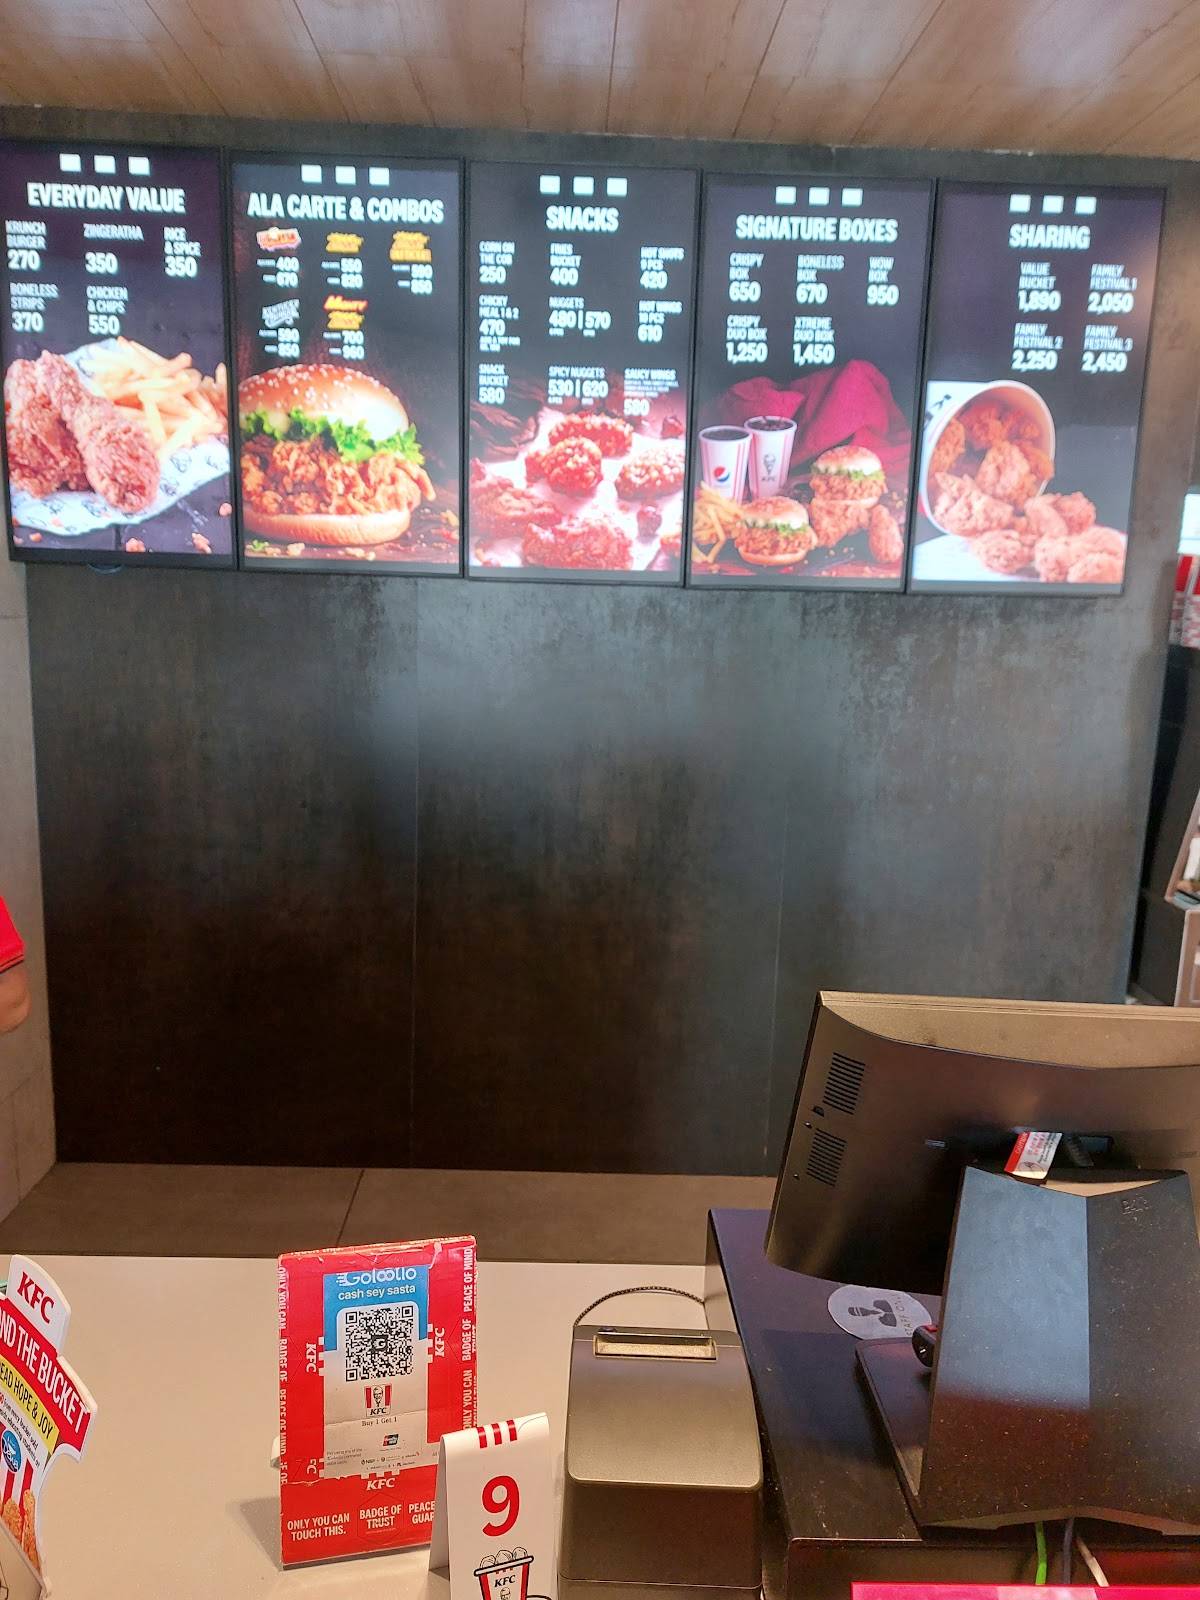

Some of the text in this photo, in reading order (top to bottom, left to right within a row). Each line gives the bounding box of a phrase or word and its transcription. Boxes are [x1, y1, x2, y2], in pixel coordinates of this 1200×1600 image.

[27, 182, 186, 214] EVERYDAY VALUE
[248, 192, 444, 224] ALA CARTE & COMBOS
[546, 206, 618, 232] SNACKS
[164, 226, 186, 241] RICE
[735, 214, 898, 243] SIGNATURE BOXES
[6, 235, 46, 249] BURGER
[1008, 224, 1091, 250] SHARING
[164, 242, 200, 256] & SPICE
[479, 241, 502, 254] CORN
[640, 246, 657, 260] HOT
[8, 250, 40, 270] 270
[84, 252, 118, 274] 350
[164, 256, 198, 278] 350
[480, 253, 513, 266] THE COB
[550, 255, 582, 268] BUCKET
[648, 259, 664, 272] PCS
[730, 252, 764, 268] CRISPY
[797, 254, 845, 270] BONELESS
[868, 256, 894, 270] WOW
[479, 266, 506, 284] 250
[550, 267, 579, 286] 400
[730, 267, 750, 280] BOX
[796, 269, 818, 282] BOX
[868, 270, 888, 283] BOX
[1020, 262, 1050, 276] VALUE
[1091, 264, 1124, 278] FAMILY
[640, 270, 668, 290] 420
[1018, 276, 1056, 290] BUCKET
[1089, 277, 1131, 291] FESTIVAL
[10, 282, 58, 298] BONELESS
[86, 286, 128, 301] CHICKEN
[728, 280, 762, 302] 650
[796, 282, 828, 304] 670
[866, 284, 900, 306] 950
[11, 297, 46, 311] STRIPS
[88, 300, 126, 314] & CHIPS
[549, 296, 584, 309] NUGGETS
[638, 300, 656, 312] HOT
[1087, 292, 1134, 315] 2,050
[479, 306, 500, 319] MEAL
[548, 310, 611, 330] 480 570
[648, 312, 664, 325] PCS
[12, 312, 44, 332] 370
[88, 314, 120, 336] 550
[480, 319, 506, 336] 470
[727, 314, 761, 328] CRISPY
[638, 324, 663, 342] 610
[726, 328, 768, 342] DUO BOX
[794, 328, 834, 342] DUO BOX
[1014, 322, 1048, 337] FAMILY
[1084, 324, 1118, 338] FAMILY
[1013, 336, 1064, 350] FESTIVAL 2
[1084, 337, 1134, 352] FESTIVAL 3
[726, 342, 768, 365] 1,250
[793, 344, 836, 366] 1,450
[1011, 350, 1058, 372] 2,250
[478, 364, 506, 375] SNACK
[1081, 352, 1128, 374] 2,450
[478, 375, 509, 386] BUCKET
[549, 366, 606, 379] SPICY NUGGETS
[624, 368, 650, 380] SAUCY
[479, 386, 505, 404] 580
[548, 378, 608, 398] 530 620
[464, 1248, 473, 1312] PEACE OF MIND
[17, 1272, 54, 1324] KFC
[338, 1284, 416, 1300] cash sey sasta
[434, 1327, 445, 1358] KFC
[462, 1318, 472, 1361] BADGE OF
[306, 1342, 317, 1372] KFC
[17, 1325, 40, 1374] THE
[38, 1351, 91, 1433] BUCKET
[463, 1370, 472, 1388] CAN
[463, 1389, 472, 1408] YOU
[14, 1376, 33, 1411] HOPE
[32, 1402, 38, 1420] &
[38, 1412, 54, 1440] JOY
[370, 1408, 387, 1416] KFC
[366, 1477, 396, 1491] KFC
[360, 1504, 402, 1520] BADGE OF
[408, 1500, 436, 1514] PEACE
[482, 1475, 520, 1536] 9
[288, 1512, 350, 1531] ONLY YOU CAN
[367, 1516, 394, 1529] TRUST
[291, 1524, 346, 1542] TOUCH THIS.
[494, 1574, 516, 1588] KFC
